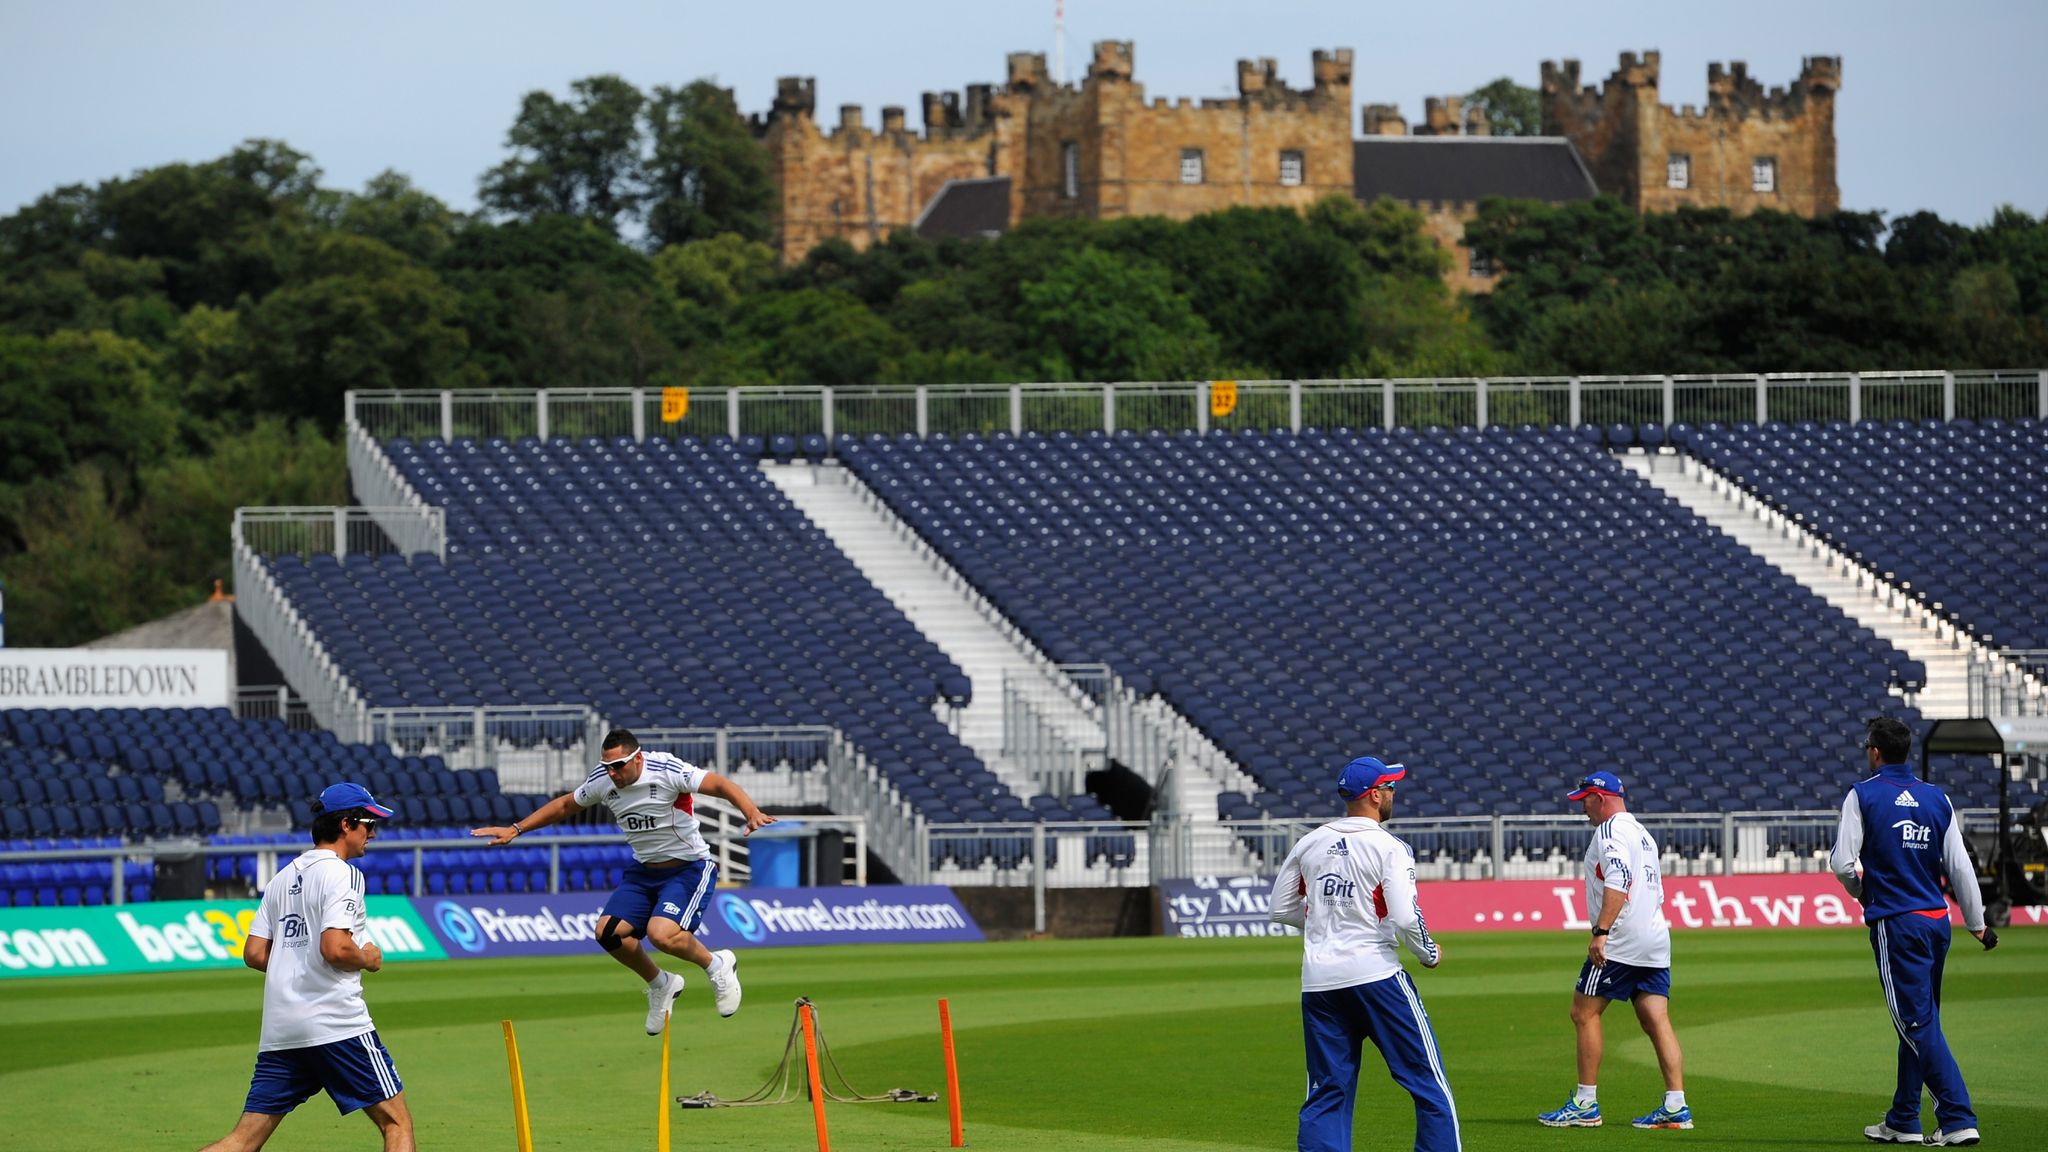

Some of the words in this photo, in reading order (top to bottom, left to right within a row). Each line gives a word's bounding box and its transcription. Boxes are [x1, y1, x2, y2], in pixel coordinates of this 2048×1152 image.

[0, 664, 197, 697] BRAMBLEDOWN
[627, 815, 656, 830] Brit
[1902, 825, 1932, 842] Brit
[1323, 879, 1356, 898] Brit
[1169, 893, 1212, 924] ty
[1217, 888, 1272, 914] Mu
